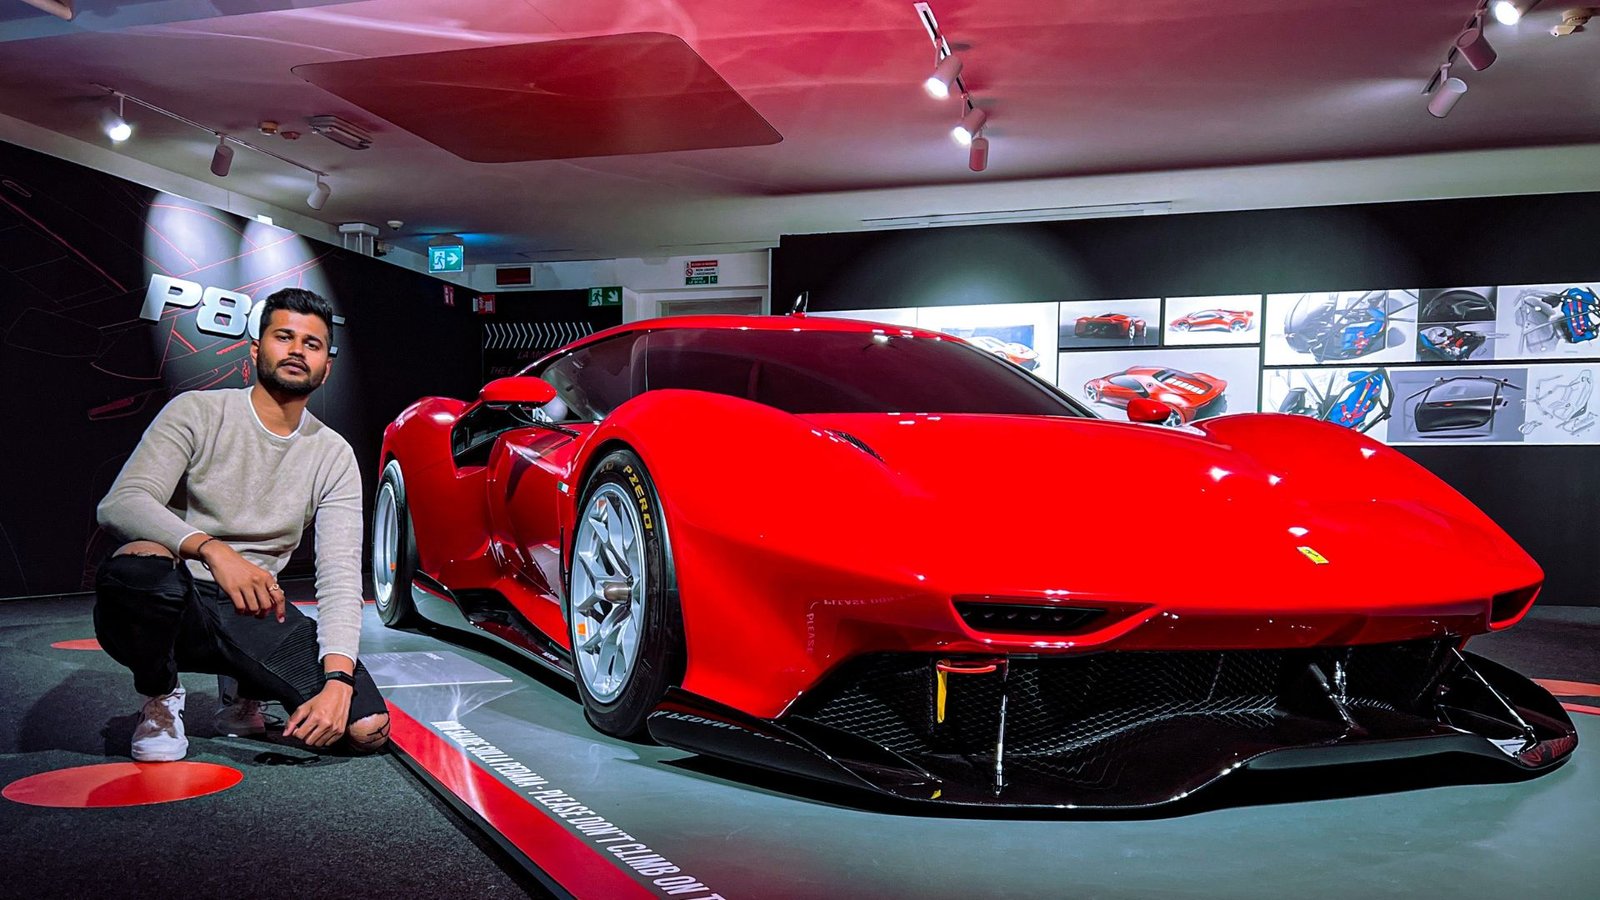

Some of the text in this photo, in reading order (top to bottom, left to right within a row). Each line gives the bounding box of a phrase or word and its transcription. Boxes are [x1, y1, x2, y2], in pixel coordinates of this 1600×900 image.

[466, 745, 514, 764] SULLA
[489, 761, 549, 787] PEDANA
[528, 789, 596, 818] PLEASE
[566, 816, 635, 844] DON'T
[606, 843, 681, 877] CLIMB
[653, 875, 710, 895] ON
